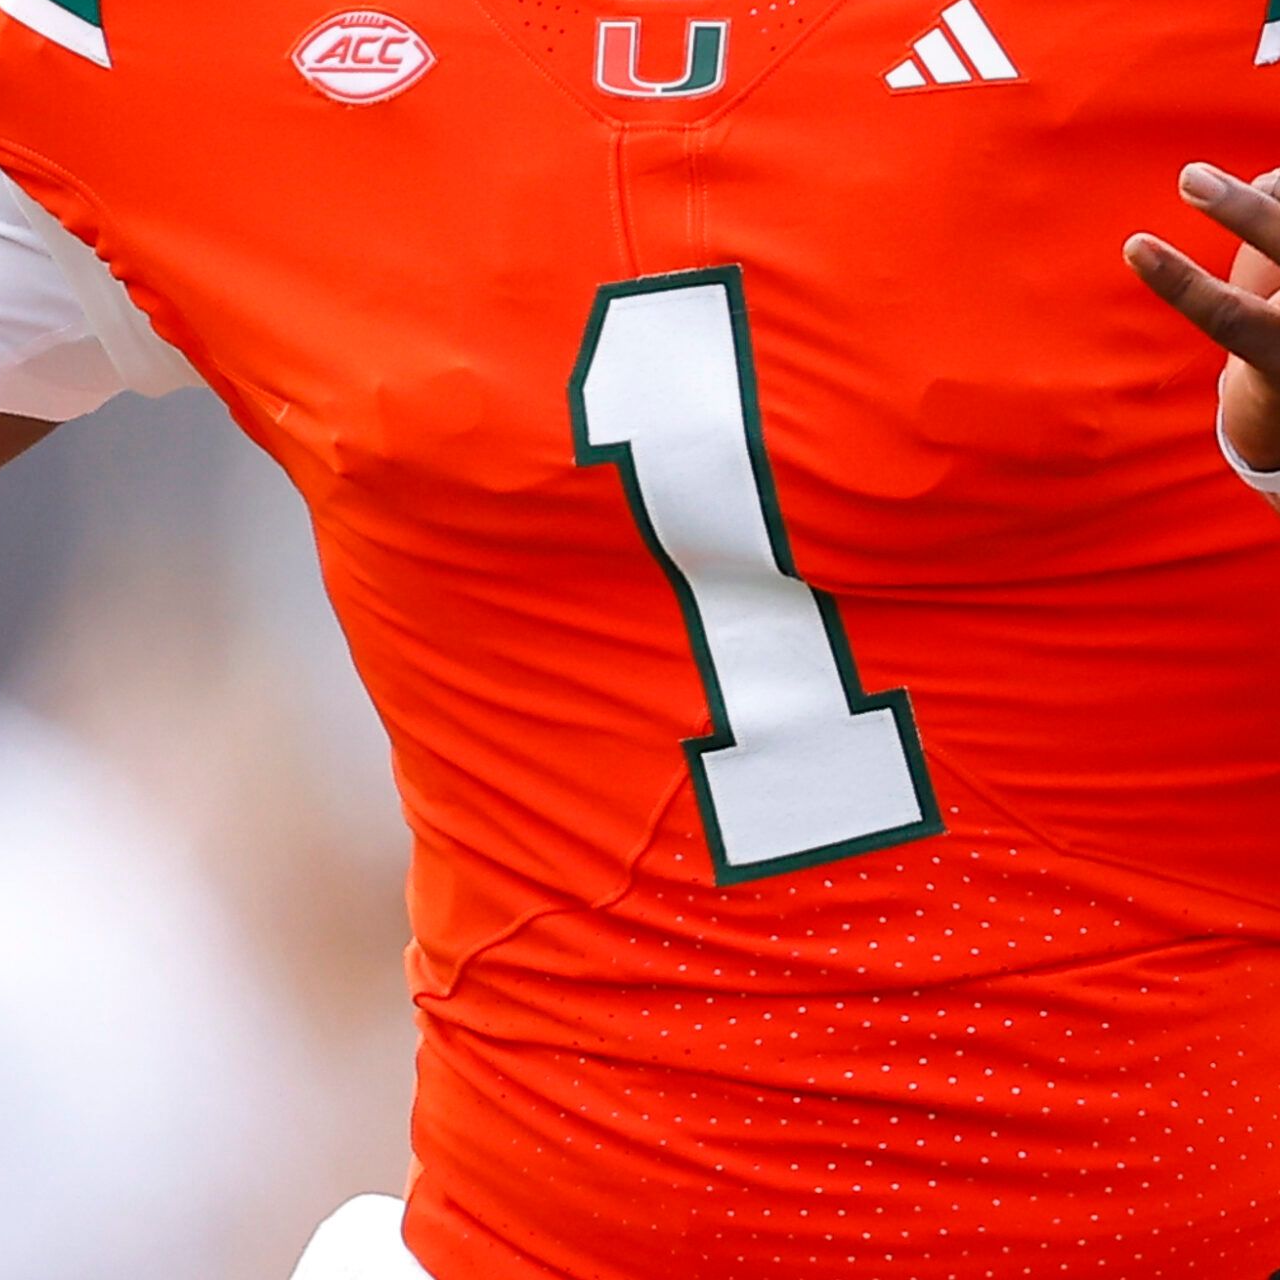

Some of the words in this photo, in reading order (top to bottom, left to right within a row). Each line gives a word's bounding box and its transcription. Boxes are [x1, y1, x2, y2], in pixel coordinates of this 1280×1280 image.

[314, 35, 410, 65] ACC
[596, 19, 728, 98] U
[567, 263, 948, 886] 1
